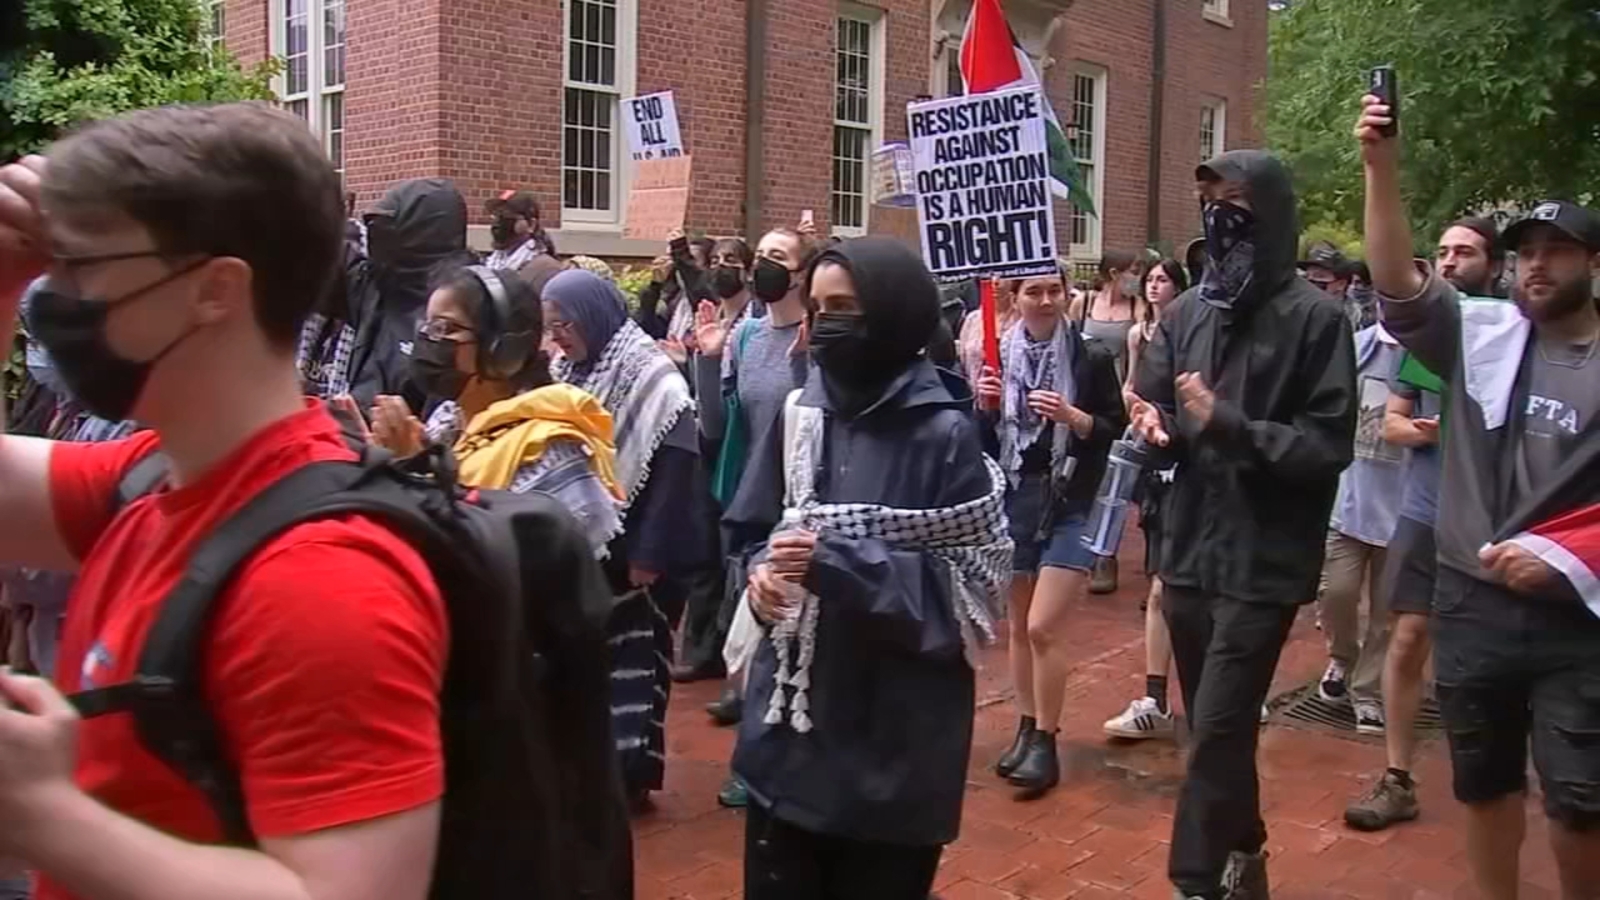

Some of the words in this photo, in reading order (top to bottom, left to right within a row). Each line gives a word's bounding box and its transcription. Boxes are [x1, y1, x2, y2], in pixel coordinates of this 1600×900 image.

[632, 97, 663, 122] END
[911, 93, 1038, 138] RESISTANCE
[640, 122, 667, 146] ALL
[934, 126, 1020, 164] AGAINST
[917, 152, 1046, 194] OCCUPATION
[923, 195, 944, 221] IS
[949, 191, 965, 218] A
[968, 181, 1047, 215] HUMAN
[926, 209, 1052, 270] RIGHT!
